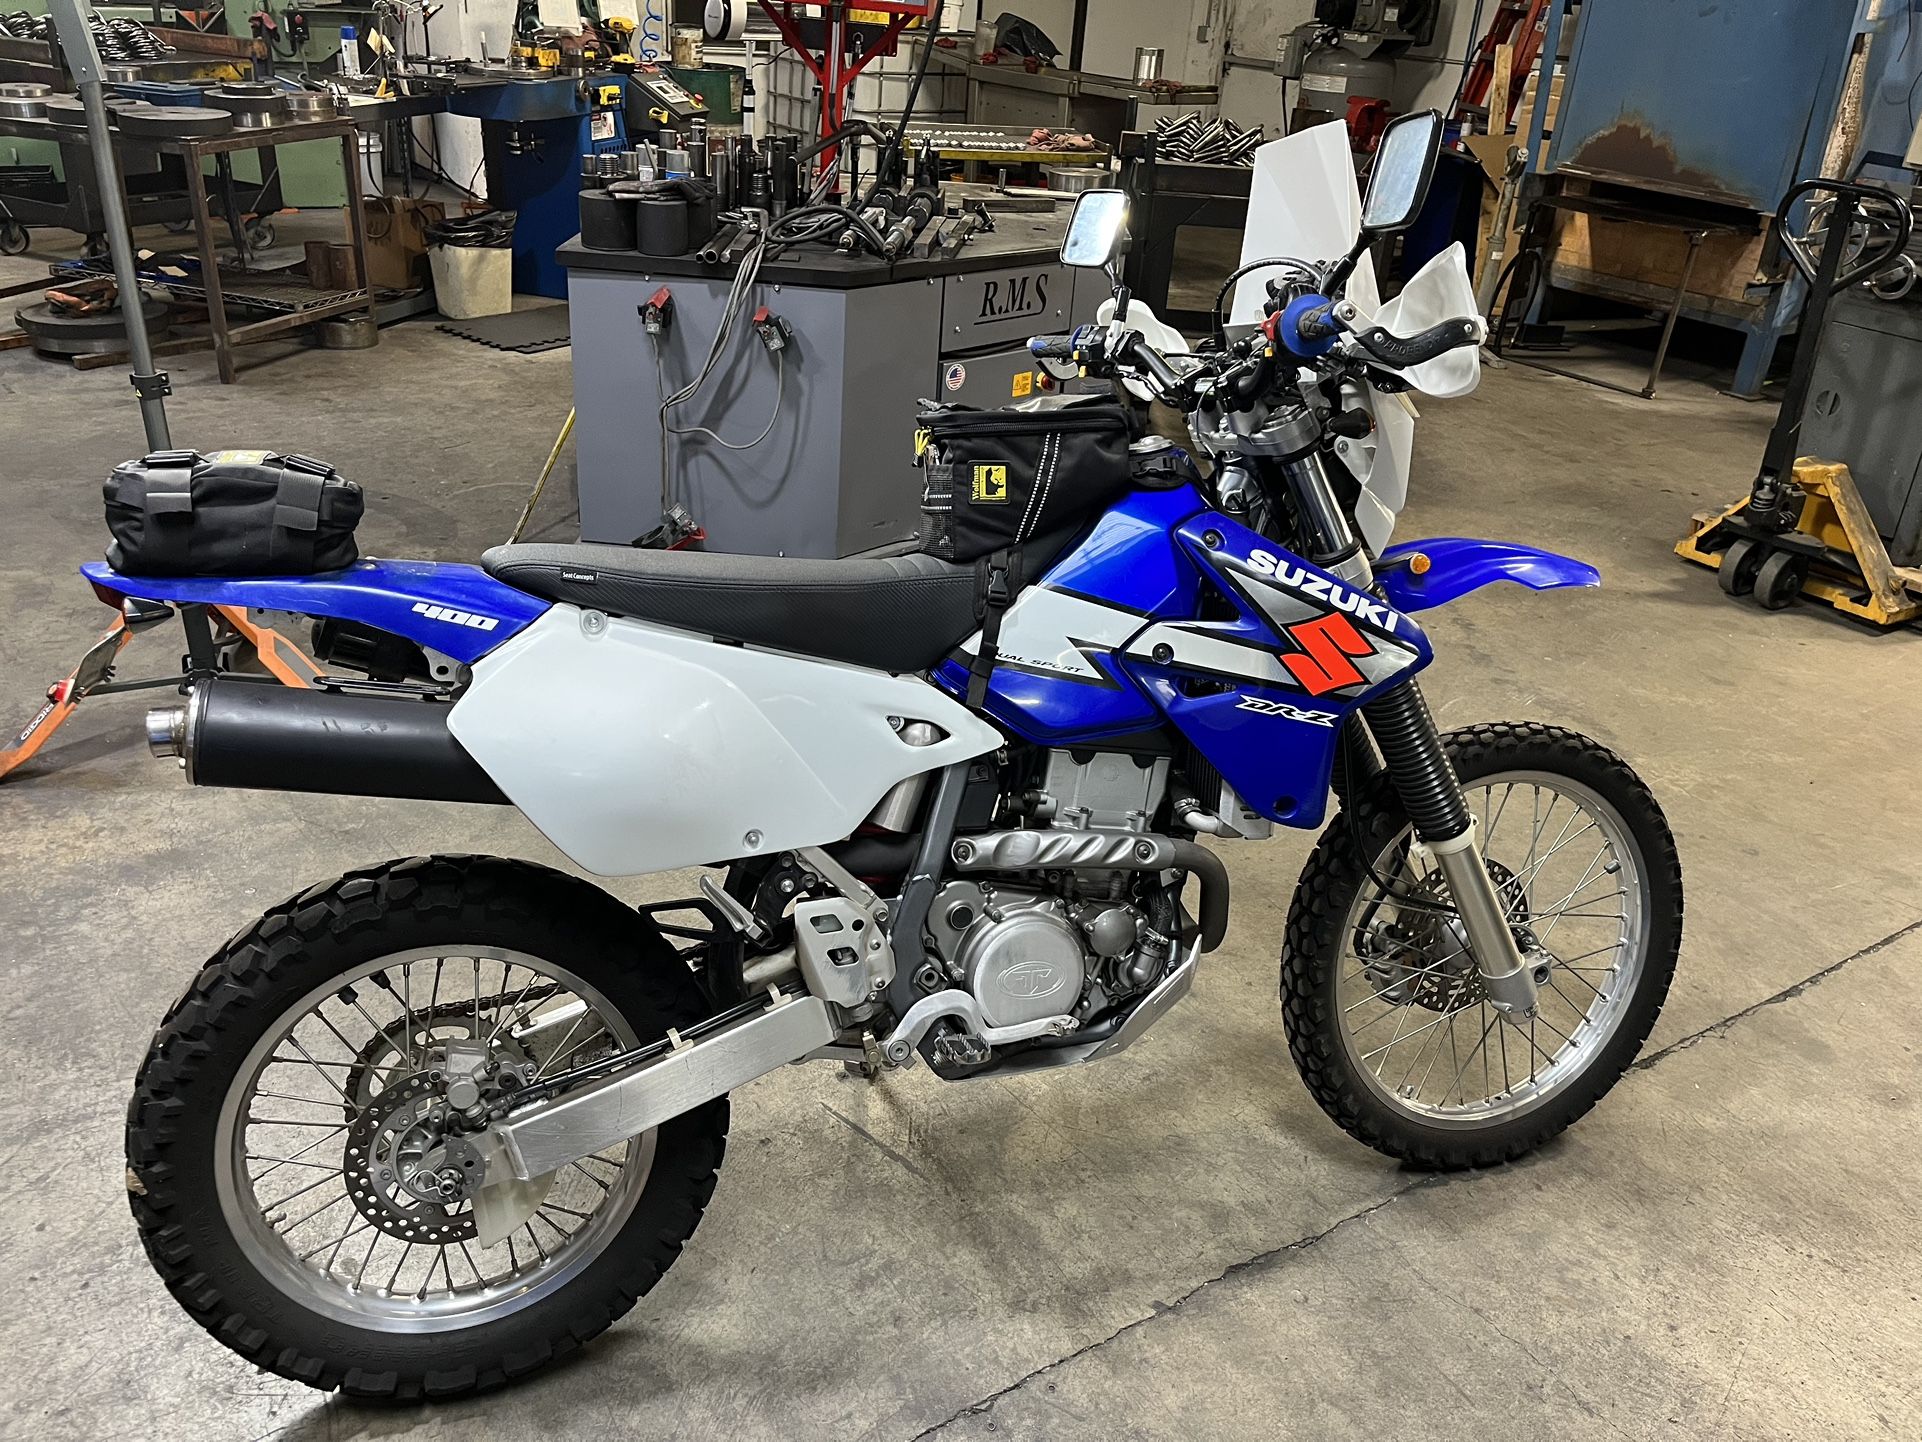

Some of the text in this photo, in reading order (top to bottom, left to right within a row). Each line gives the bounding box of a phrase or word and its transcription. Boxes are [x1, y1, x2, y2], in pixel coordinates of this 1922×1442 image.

[978, 273, 1048, 318] R.M.S
[971, 465, 980, 501] Wolfman
[1247, 549, 1399, 633] SUZUKI
[411, 602, 500, 631] 400
[997, 652, 1084, 673] UAL SPORT
[20, 702, 55, 741] RIDGID
[1235, 694, 1339, 728] DR-Z
